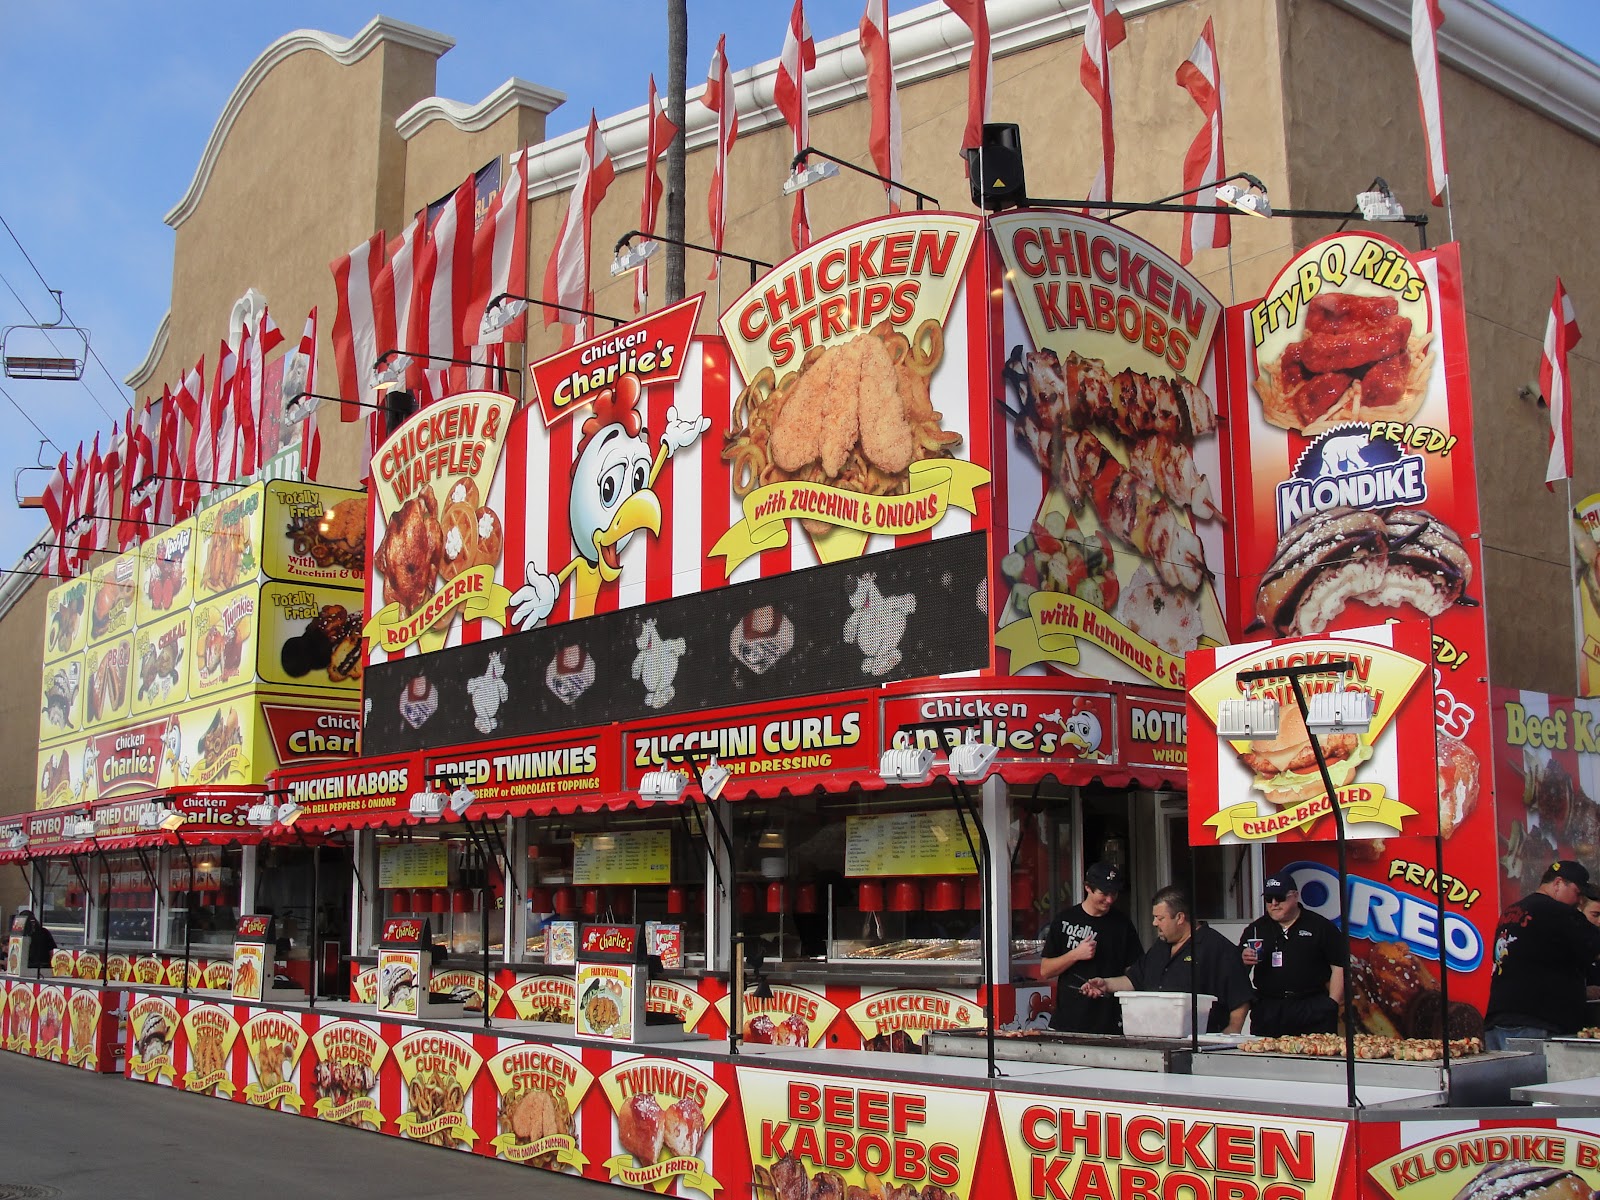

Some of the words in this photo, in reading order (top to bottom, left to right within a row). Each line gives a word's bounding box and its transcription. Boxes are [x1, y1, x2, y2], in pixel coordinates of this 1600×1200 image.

[1012, 227, 1207, 340] CHICKEN
[1350, 240, 1426, 302] Ribs
[739, 230, 960, 343] CHICKEN
[768, 279, 921, 367] STRIPS
[1034, 281, 1191, 372] KABOBS
[581, 329, 647, 365] Chicken
[553, 340, 675, 407] Charlie's
[380, 403, 480, 482] CHICKEN
[481, 404, 501, 442] &
[1369, 421, 1458, 457] FRIED!
[391, 441, 486, 504] WAFFLES
[277, 490, 319, 505] Totally
[289, 502, 323, 518] Fried
[755, 489, 787, 521] with
[790, 487, 859, 522] ZUCCHINI
[862, 506, 872, 525] &
[876, 493, 938, 528] ONIONS
[1281, 461, 1422, 535] KLONDIKE
[287, 564, 336, 578] Zucchini
[340, 570, 348, 578] &
[288, 555, 315, 568] with
[272, 591, 314, 606] Totally
[284, 602, 319, 620] Fried
[387, 573, 484, 645] ROTISSERIE
[222, 594, 254, 635] Twinkies
[158, 620, 187, 650] CEREAL
[1040, 602, 1078, 629] with
[1083, 609, 1152, 672] Hummus
[1155, 655, 1165, 679] &
[921, 698, 1028, 719] Chicken
[762, 712, 861, 753] CURLS
[1504, 701, 1568, 751] Beef
[115, 733, 145, 751] Chicken
[103, 747, 155, 783] Charlie's
[493, 745, 597, 783] TWINKIES
[750, 753, 832, 775] DRESSING
[288, 776, 344, 803] CHICKEN
[347, 768, 408, 797] KABOBS
[501, 789, 509, 797] or
[510, 782, 556, 797] CHOCOLATE
[557, 777, 599, 793] TOPPINGS
[95, 808, 121, 826] FRIED
[183, 798, 226, 808] Chicken
[300, 806, 311, 815] ith
[313, 803, 328, 814] BELL
[329, 800, 360, 812] PEPPERS
[362, 800, 366, 809] &
[368, 797, 396, 808] ONIONS
[1243, 788, 1372, 834] CHAR-BROLED
[1291, 868, 1479, 961] OREO
[599, 932, 632, 952] Charlie's
[1061, 920, 1097, 941] Totally
[429, 974, 475, 993] KLONDIKE
[590, 967, 600, 977] FAIR
[602, 967, 619, 978] SPECIAL
[132, 1002, 163, 1020] KLONDIKE
[164, 1006, 177, 1026] BAR
[532, 996, 571, 1012] CURLS
[683, 994, 694, 1010] &
[743, 990, 819, 1022] WINKIES
[865, 994, 950, 1019] CHICKEN
[956, 1005, 971, 1024] &
[192, 1010, 230, 1033] CHICKEN
[197, 1026, 224, 1044] STRIPS
[251, 1019, 300, 1049] AVOCADOS
[323, 1027, 377, 1056] CHICKEN
[326, 1045, 373, 1068] KABOBS
[402, 1037, 472, 1070] ZUCCHINI
[415, 1056, 457, 1077] CURLS
[502, 1051, 577, 1086] CHICKEN
[253, 1089, 274, 1102] TOTALLY
[275, 1085, 293, 1095] FRIED!
[512, 1071, 567, 1098] STRIPS
[615, 1066, 708, 1109] TWINKIES
[787, 1080, 927, 1135] BEEF
[409, 1121, 437, 1136] TOTALLY
[439, 1115, 463, 1129] FRIED!
[521, 1143, 540, 1159] ONIONS
[545, 1136, 570, 1151] ZUCCHINI
[761, 1118, 960, 1187] KABOBS
[1020, 1104, 1315, 1183] CHICKEN
[622, 1163, 662, 1183] TOTALLY
[665, 1159, 699, 1174] FRIED!
[1390, 1135, 1566, 1190] KLONDIKE
[1576, 1141, 1600, 1169] B
